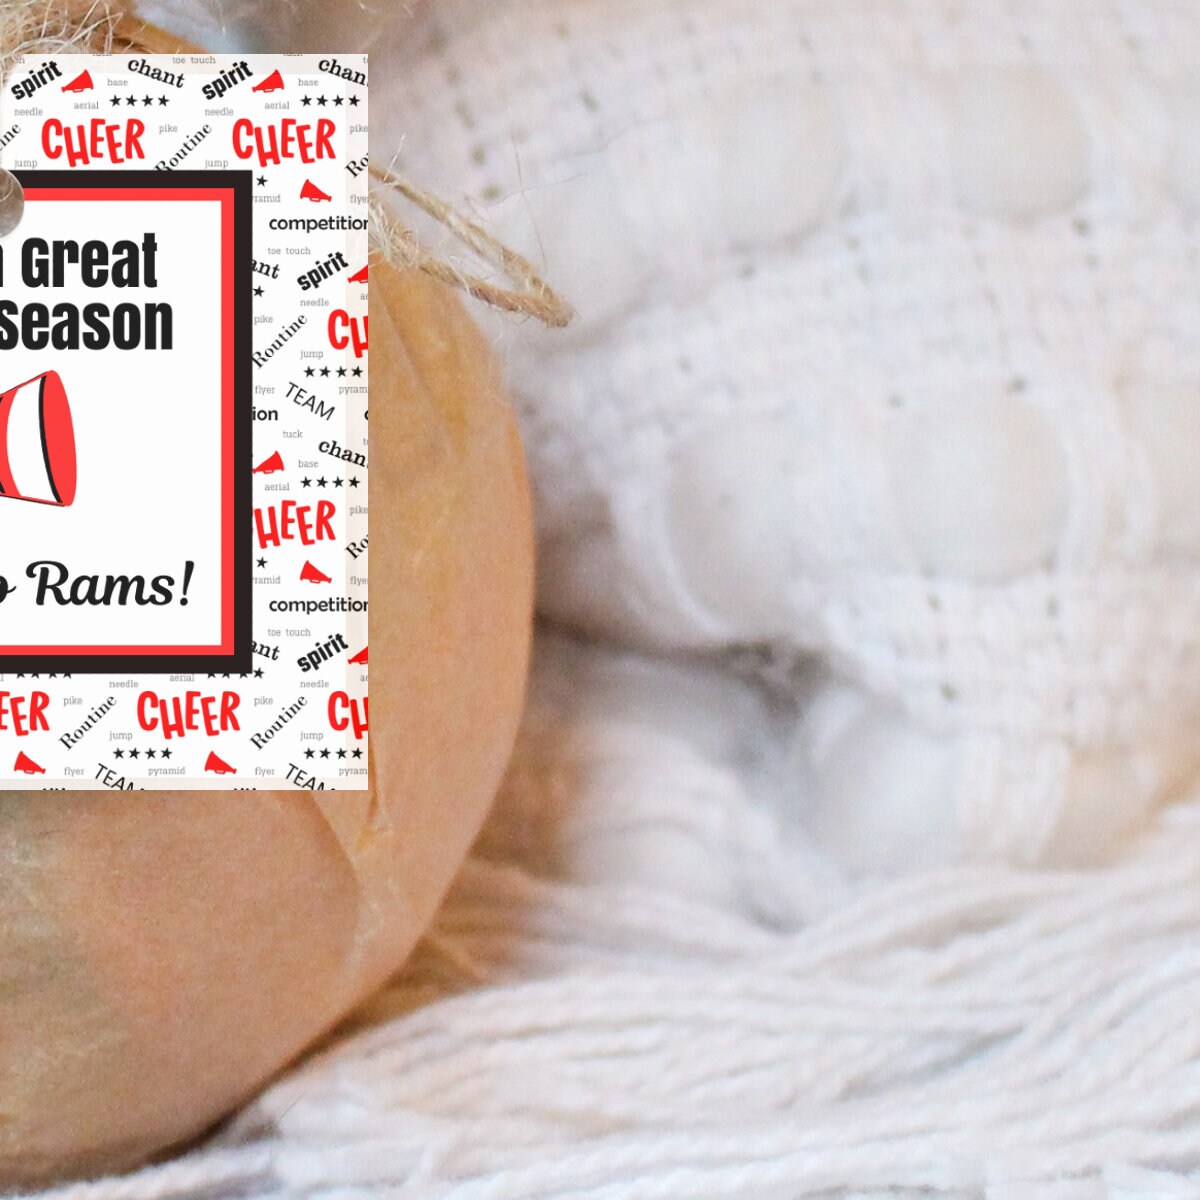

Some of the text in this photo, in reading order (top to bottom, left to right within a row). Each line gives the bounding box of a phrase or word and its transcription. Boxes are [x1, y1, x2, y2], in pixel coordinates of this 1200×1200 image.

[172, 56, 216, 64] toe touch
[127, 59, 185, 88] chant
[318, 59, 368, 87] chan
[10, 60, 63, 100] spirit
[201, 60, 254, 100] spirit
[74, 101, 99, 109] aerial
[264, 101, 290, 109] aerial
[14, 106, 43, 116] needle
[205, 106, 234, 116] needle
[159, 124, 177, 134] pike
[41, 118, 145, 167] CHEER
[232, 118, 336, 167] CHEER
[14, 158, 38, 169] jump
[205, 158, 228, 169] jump
[267, 247, 311, 255] toe touch
[22, 233, 158, 288] Great
[297, 251, 349, 291] spirit
[300, 297, 329, 307] needle
[254, 315, 273, 325] pike
[252, 315, 308, 369] Routine
[300, 349, 324, 359] jump
[254, 385, 275, 395] flyer
[338, 385, 368, 395] pyram
[284, 382, 336, 421] TEAM
[283, 430, 302, 438] tuck
[318, 440, 368, 468] chan
[297, 460, 319, 468] base
[264, 482, 290, 491] aerial
[252, 499, 336, 549] HEER
[26, 560, 195, 607] Rams!
[267, 628, 311, 636] toe touch
[297, 632, 349, 672] spirit
[169, 673, 194, 681] aerial
[109, 678, 138, 688] needle
[300, 678, 329, 688] needle
[63, 696, 82, 706] pike
[254, 696, 273, 706] pike
[136, 690, 240, 739] CHEER
[58, 696, 117, 751] Routine
[248, 696, 308, 751] Routine
[109, 730, 133, 741] jump
[300, 730, 324, 741] jump
[63, 766, 84, 776] flyer
[147, 766, 185, 776] pyramid
[254, 766, 275, 776] flyer
[338, 766, 368, 776] pyram
